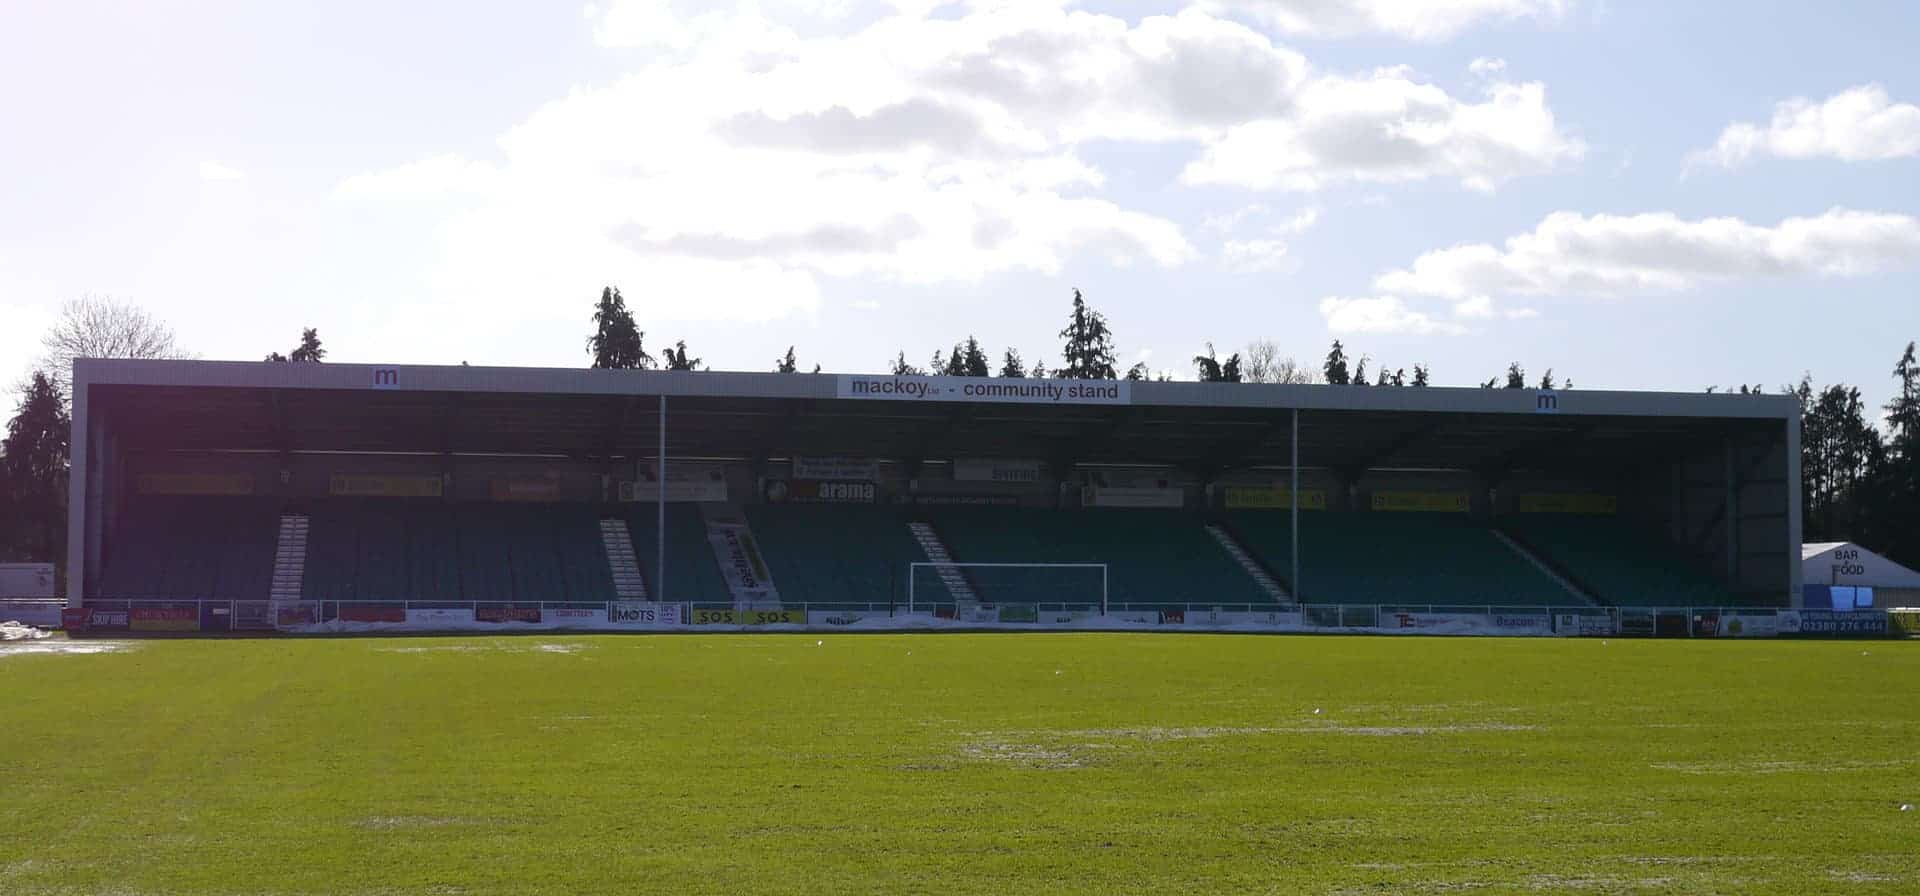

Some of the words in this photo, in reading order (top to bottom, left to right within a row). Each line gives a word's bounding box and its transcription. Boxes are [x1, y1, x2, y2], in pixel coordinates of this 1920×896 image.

[375, 369, 397, 385] m
[852, 378, 928, 399] mackoy
[963, 382, 1064, 400] community
[1068, 383, 1119, 399] stand
[1537, 394, 1557, 409] m
[1834, 550, 1858, 560] BAR
[1832, 564, 1864, 576] FOOD
[92, 614, 111, 625] SKIP
[111, 614, 128, 625] HIRE
[617, 609, 655, 621] MOTS
[700, 611, 733, 623] SOS
[757, 611, 790, 623] SOS
